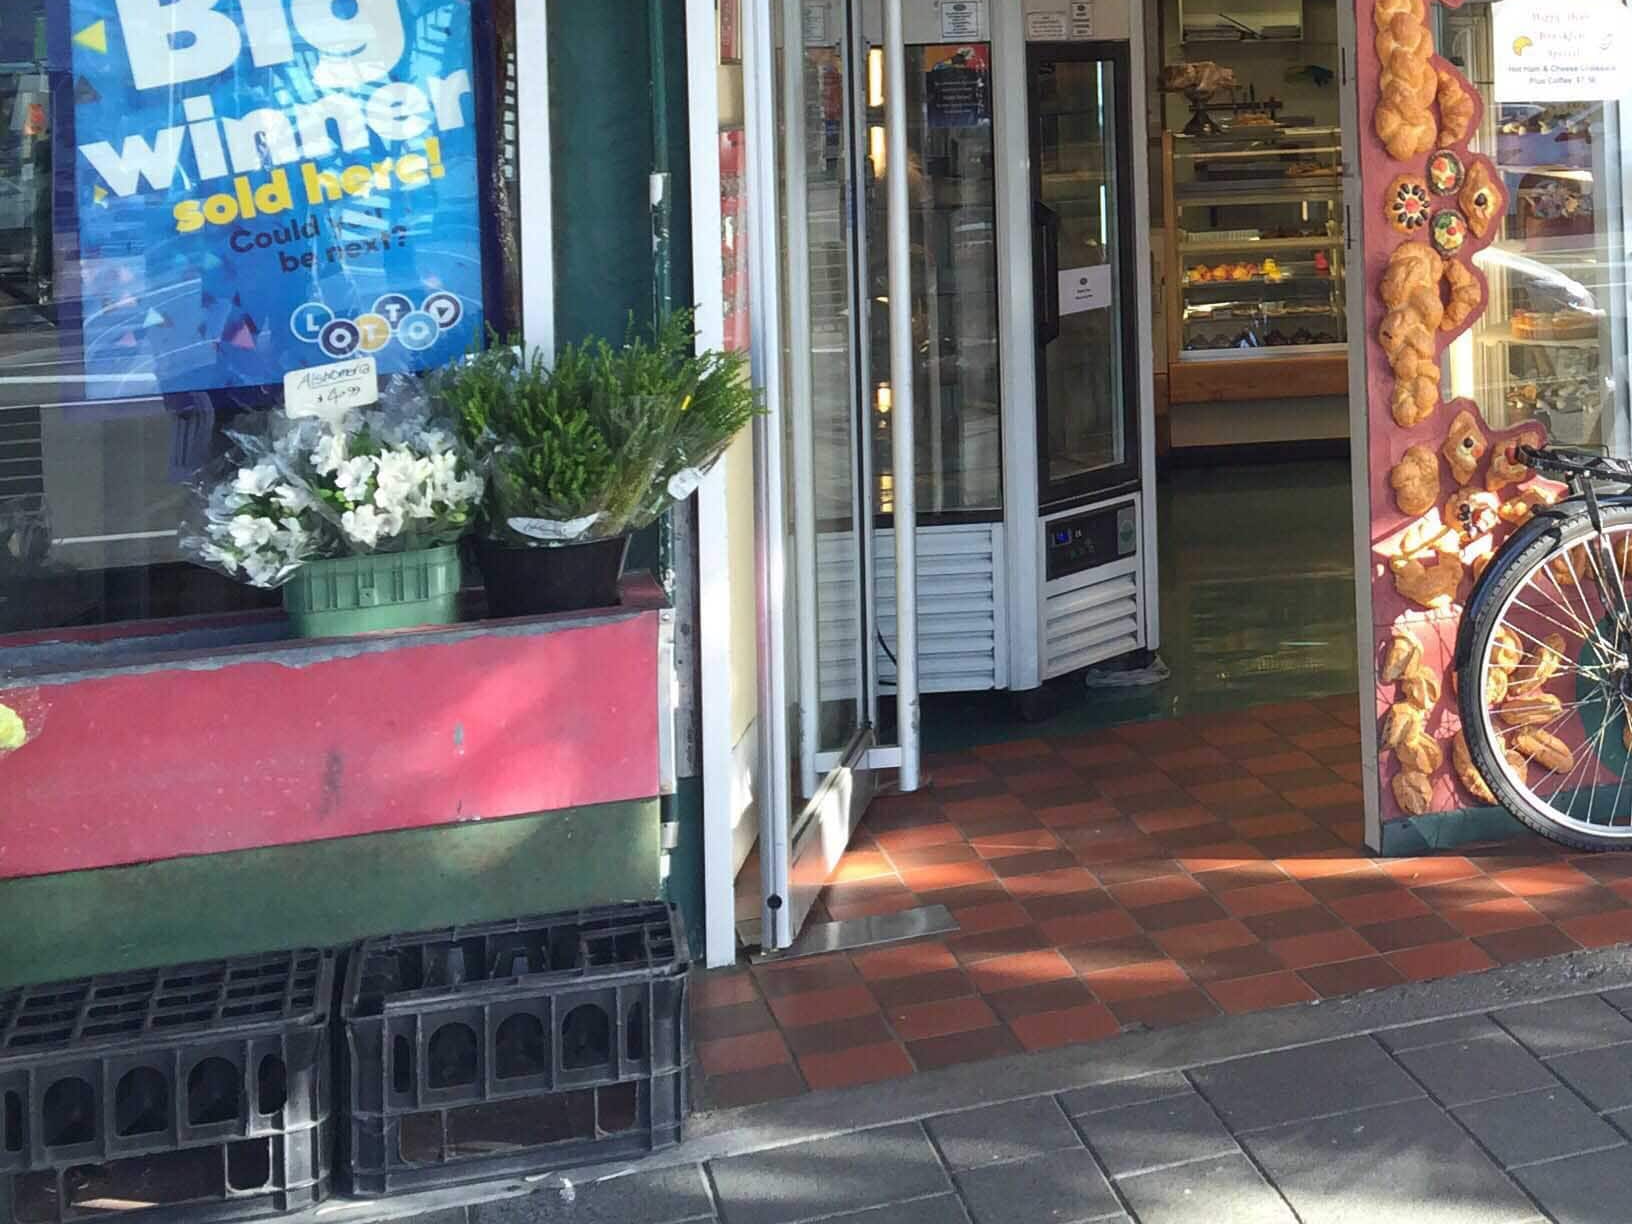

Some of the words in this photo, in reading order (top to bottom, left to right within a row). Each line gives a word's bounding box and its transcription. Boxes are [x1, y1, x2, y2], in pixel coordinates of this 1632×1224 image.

[80, 67, 473, 197] winner
[173, 169, 292, 233] sold
[303, 137, 446, 216] here!
[230, 213, 320, 253] Could
[279, 250, 316, 273] be
[306, 303, 431, 349] LOTTO
